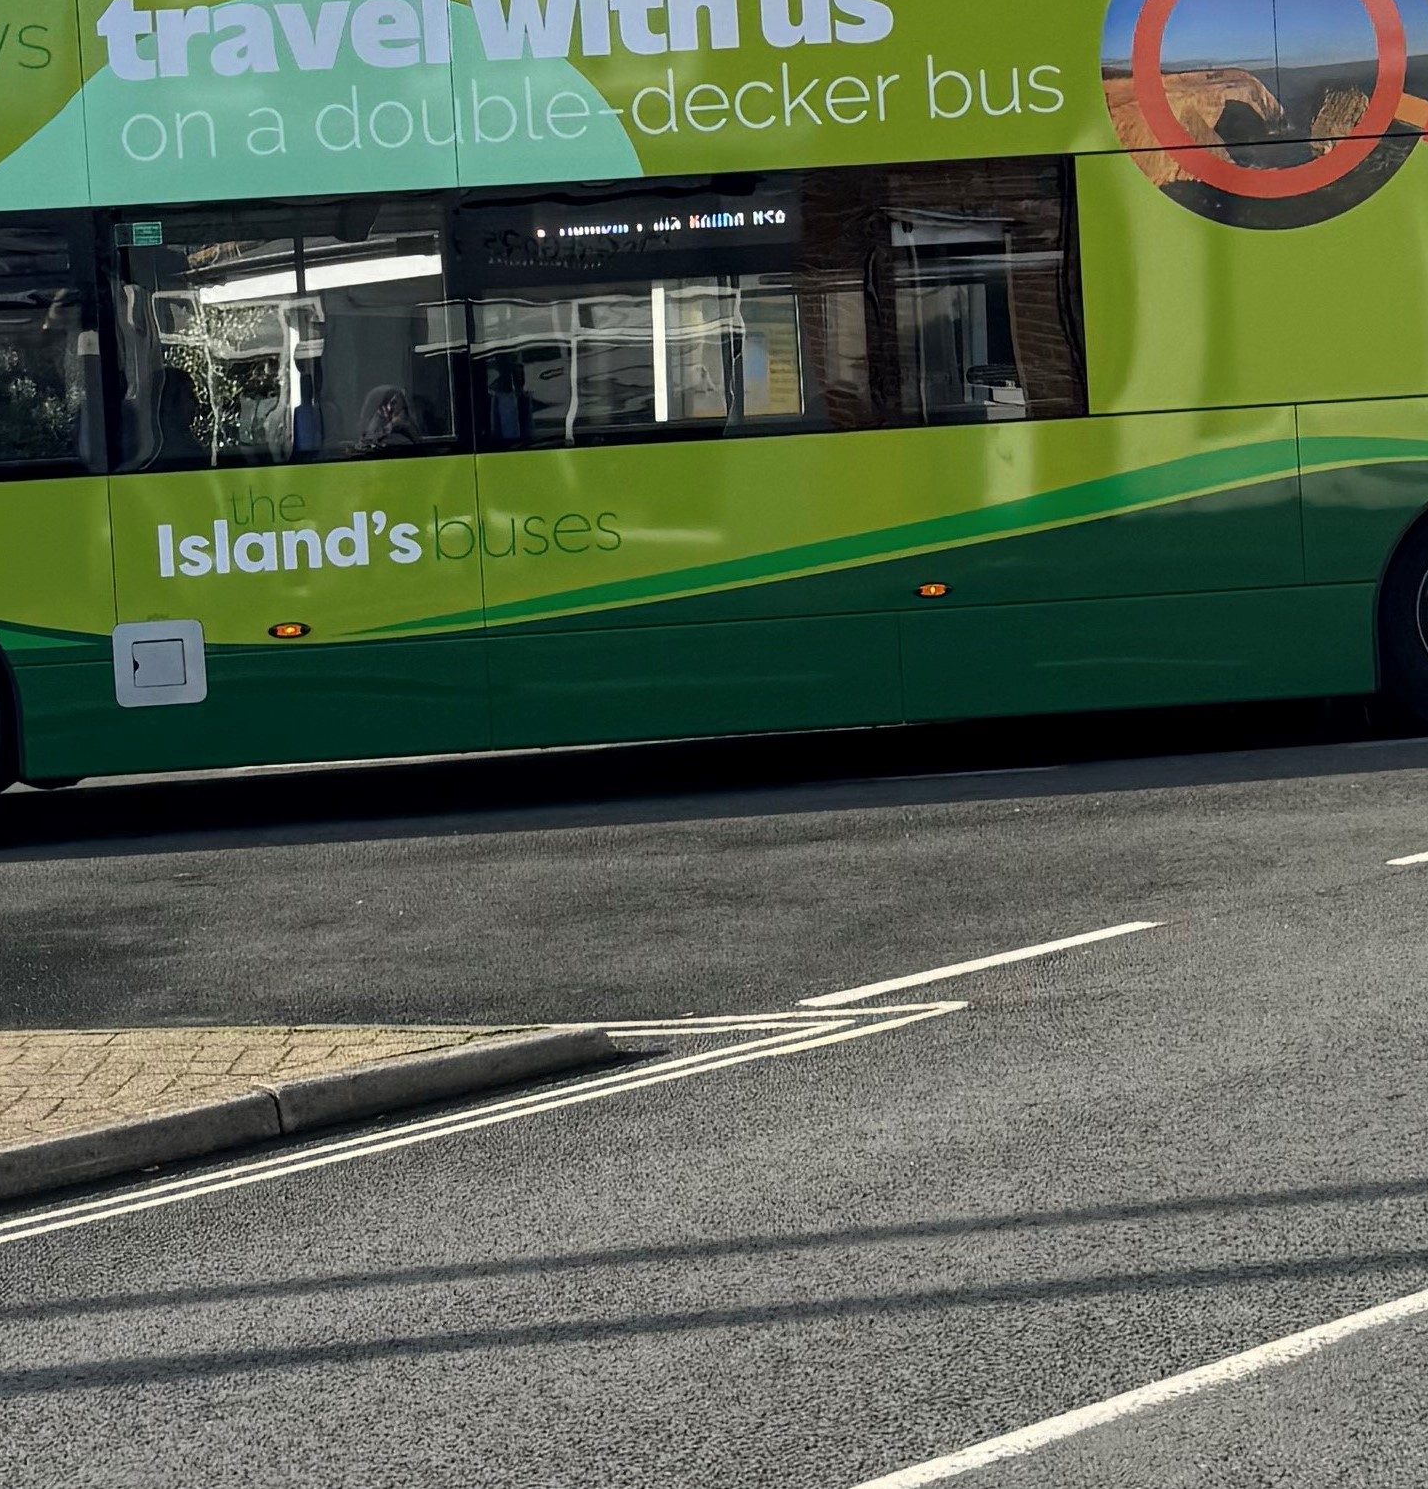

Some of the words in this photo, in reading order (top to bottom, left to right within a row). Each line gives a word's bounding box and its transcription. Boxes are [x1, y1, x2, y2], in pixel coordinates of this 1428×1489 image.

[120, 107, 219, 163] on
[246, 107, 288, 156] a
[314, 61, 900, 152] double-decker
[926, 55, 1065, 121] bus
[157, 509, 422, 578] Island's
[433, 505, 623, 562] buses
[227, 487, 307, 526] the
